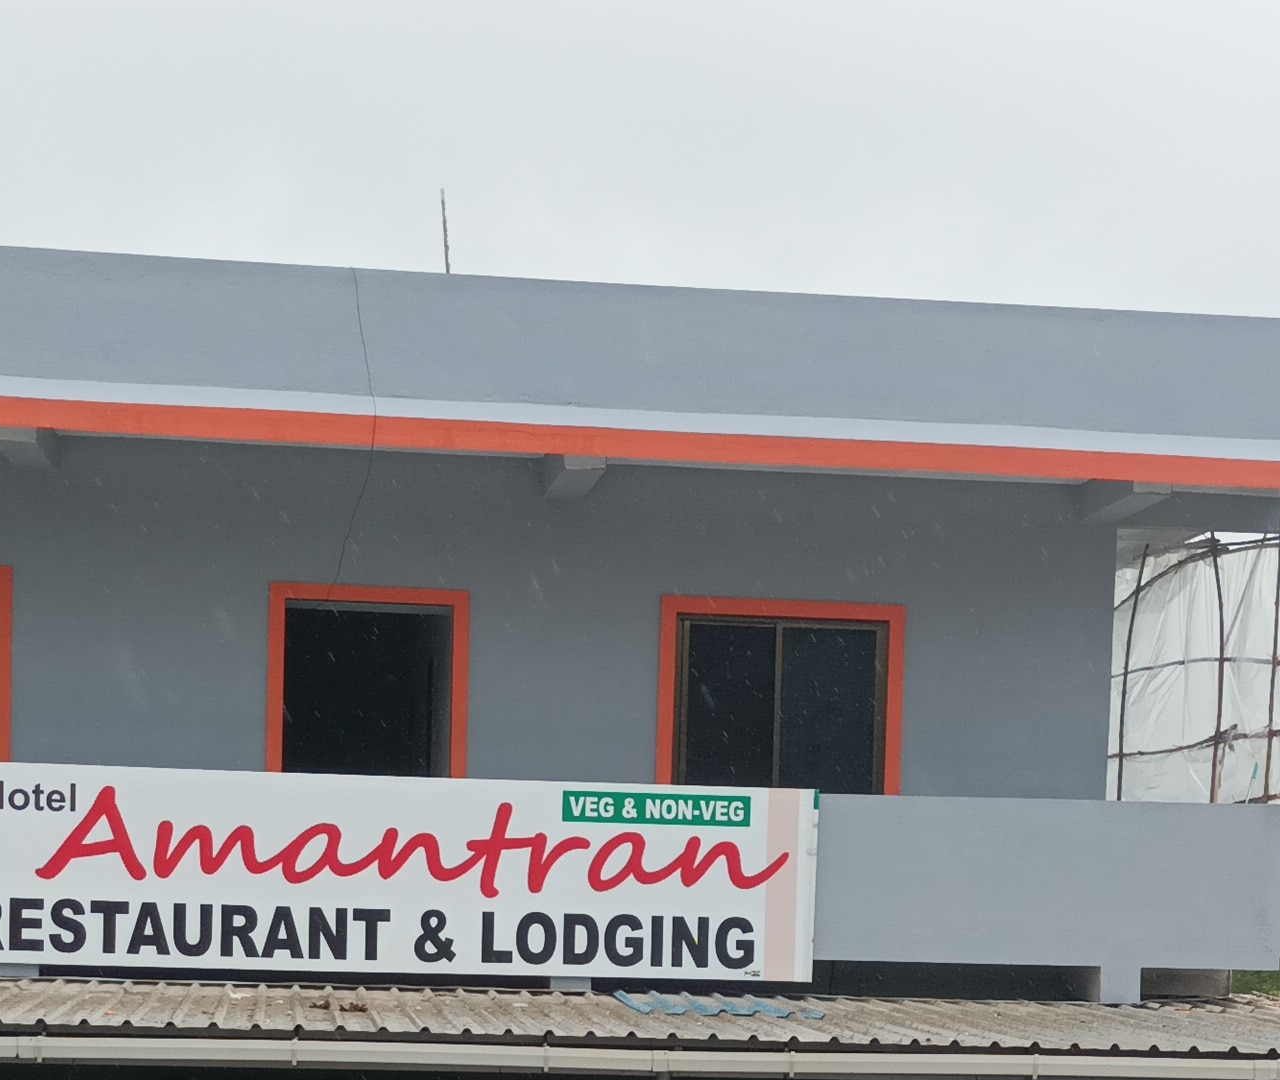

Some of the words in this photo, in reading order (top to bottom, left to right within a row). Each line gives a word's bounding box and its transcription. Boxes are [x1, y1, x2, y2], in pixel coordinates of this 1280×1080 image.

[569, 796, 615, 818] VEG
[621, 797, 639, 819] &
[644, 798, 746, 822] NON-VEG
[34, 785, 790, 898] Amantran
[413, 908, 458, 963] &
[481, 910, 756, 969] LODGING
